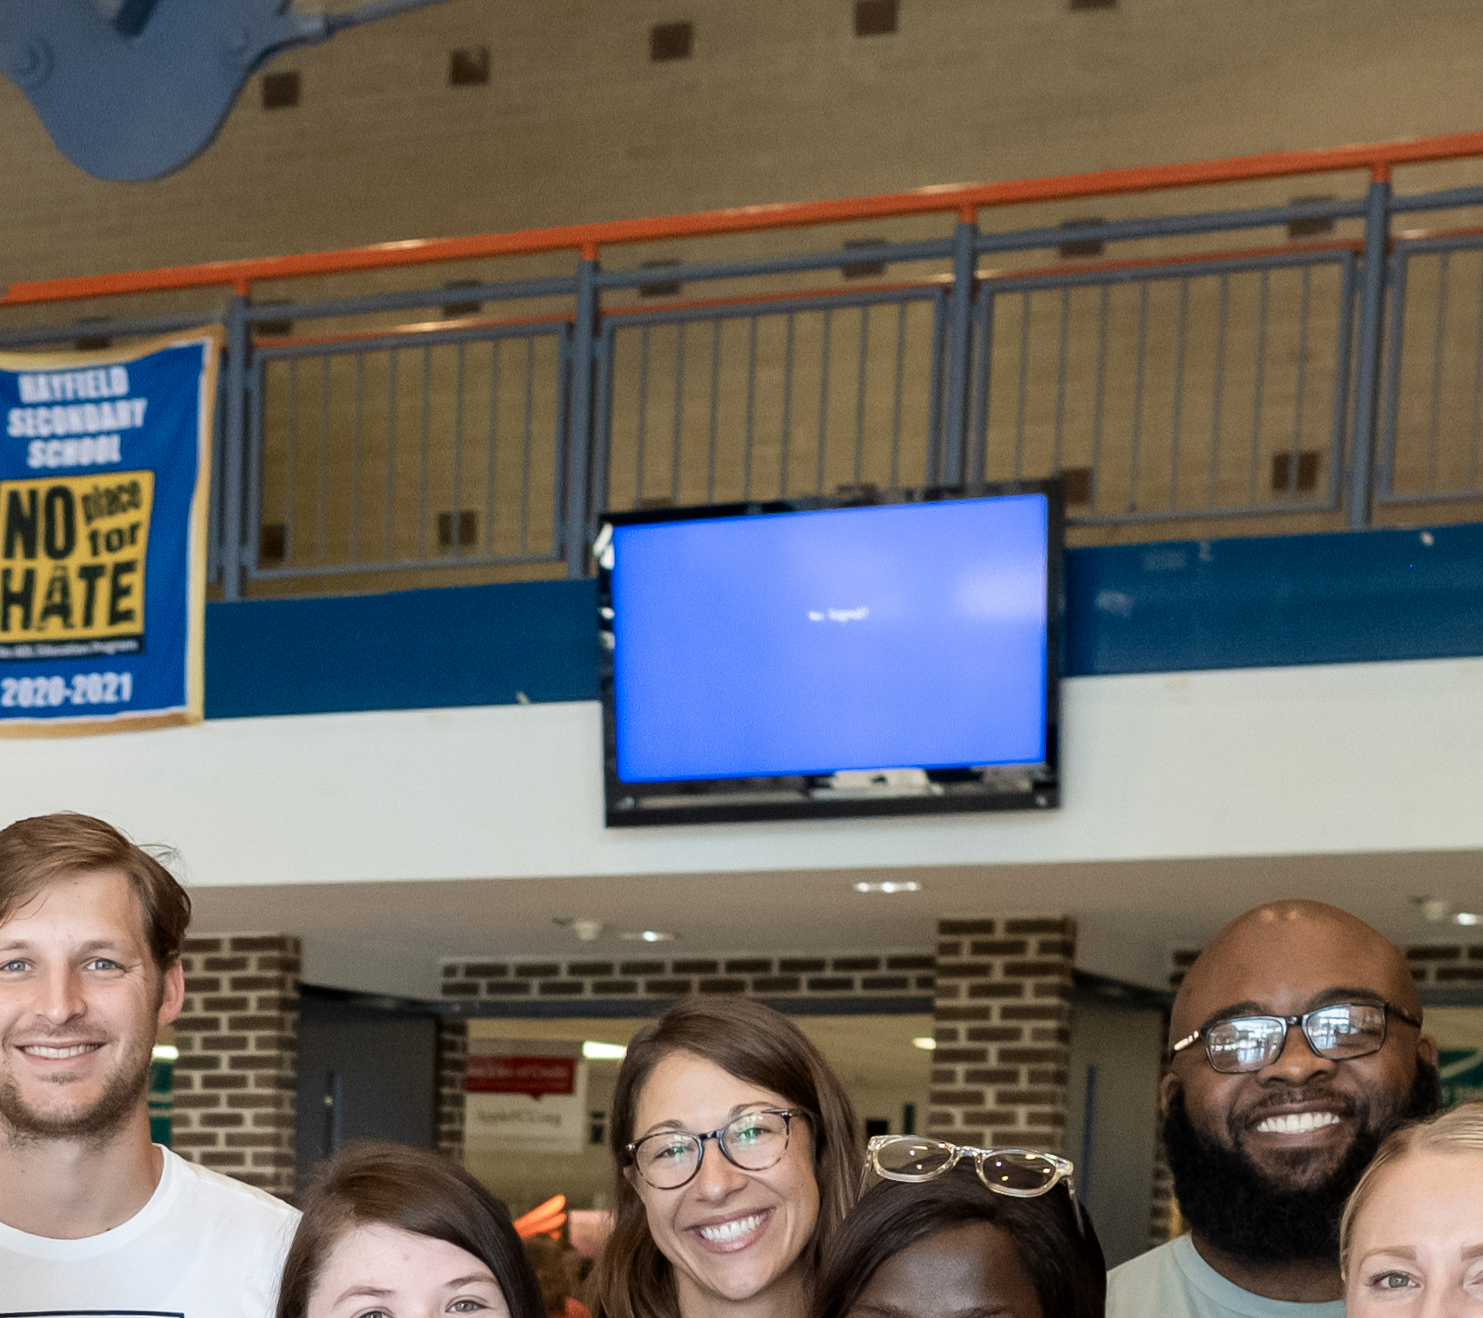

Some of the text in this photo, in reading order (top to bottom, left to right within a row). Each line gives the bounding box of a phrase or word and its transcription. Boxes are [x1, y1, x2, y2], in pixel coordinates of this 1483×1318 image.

[18, 365, 129, 404] HAYFIELD
[6, 397, 148, 437] SECONDARY
[26, 434, 122, 469] SCHOOL
[3, 480, 141, 560] NO place
[88, 522, 141, 556] for
[0, 560, 137, 632] HATE
[0, 672, 133, 708] 2020-2021
